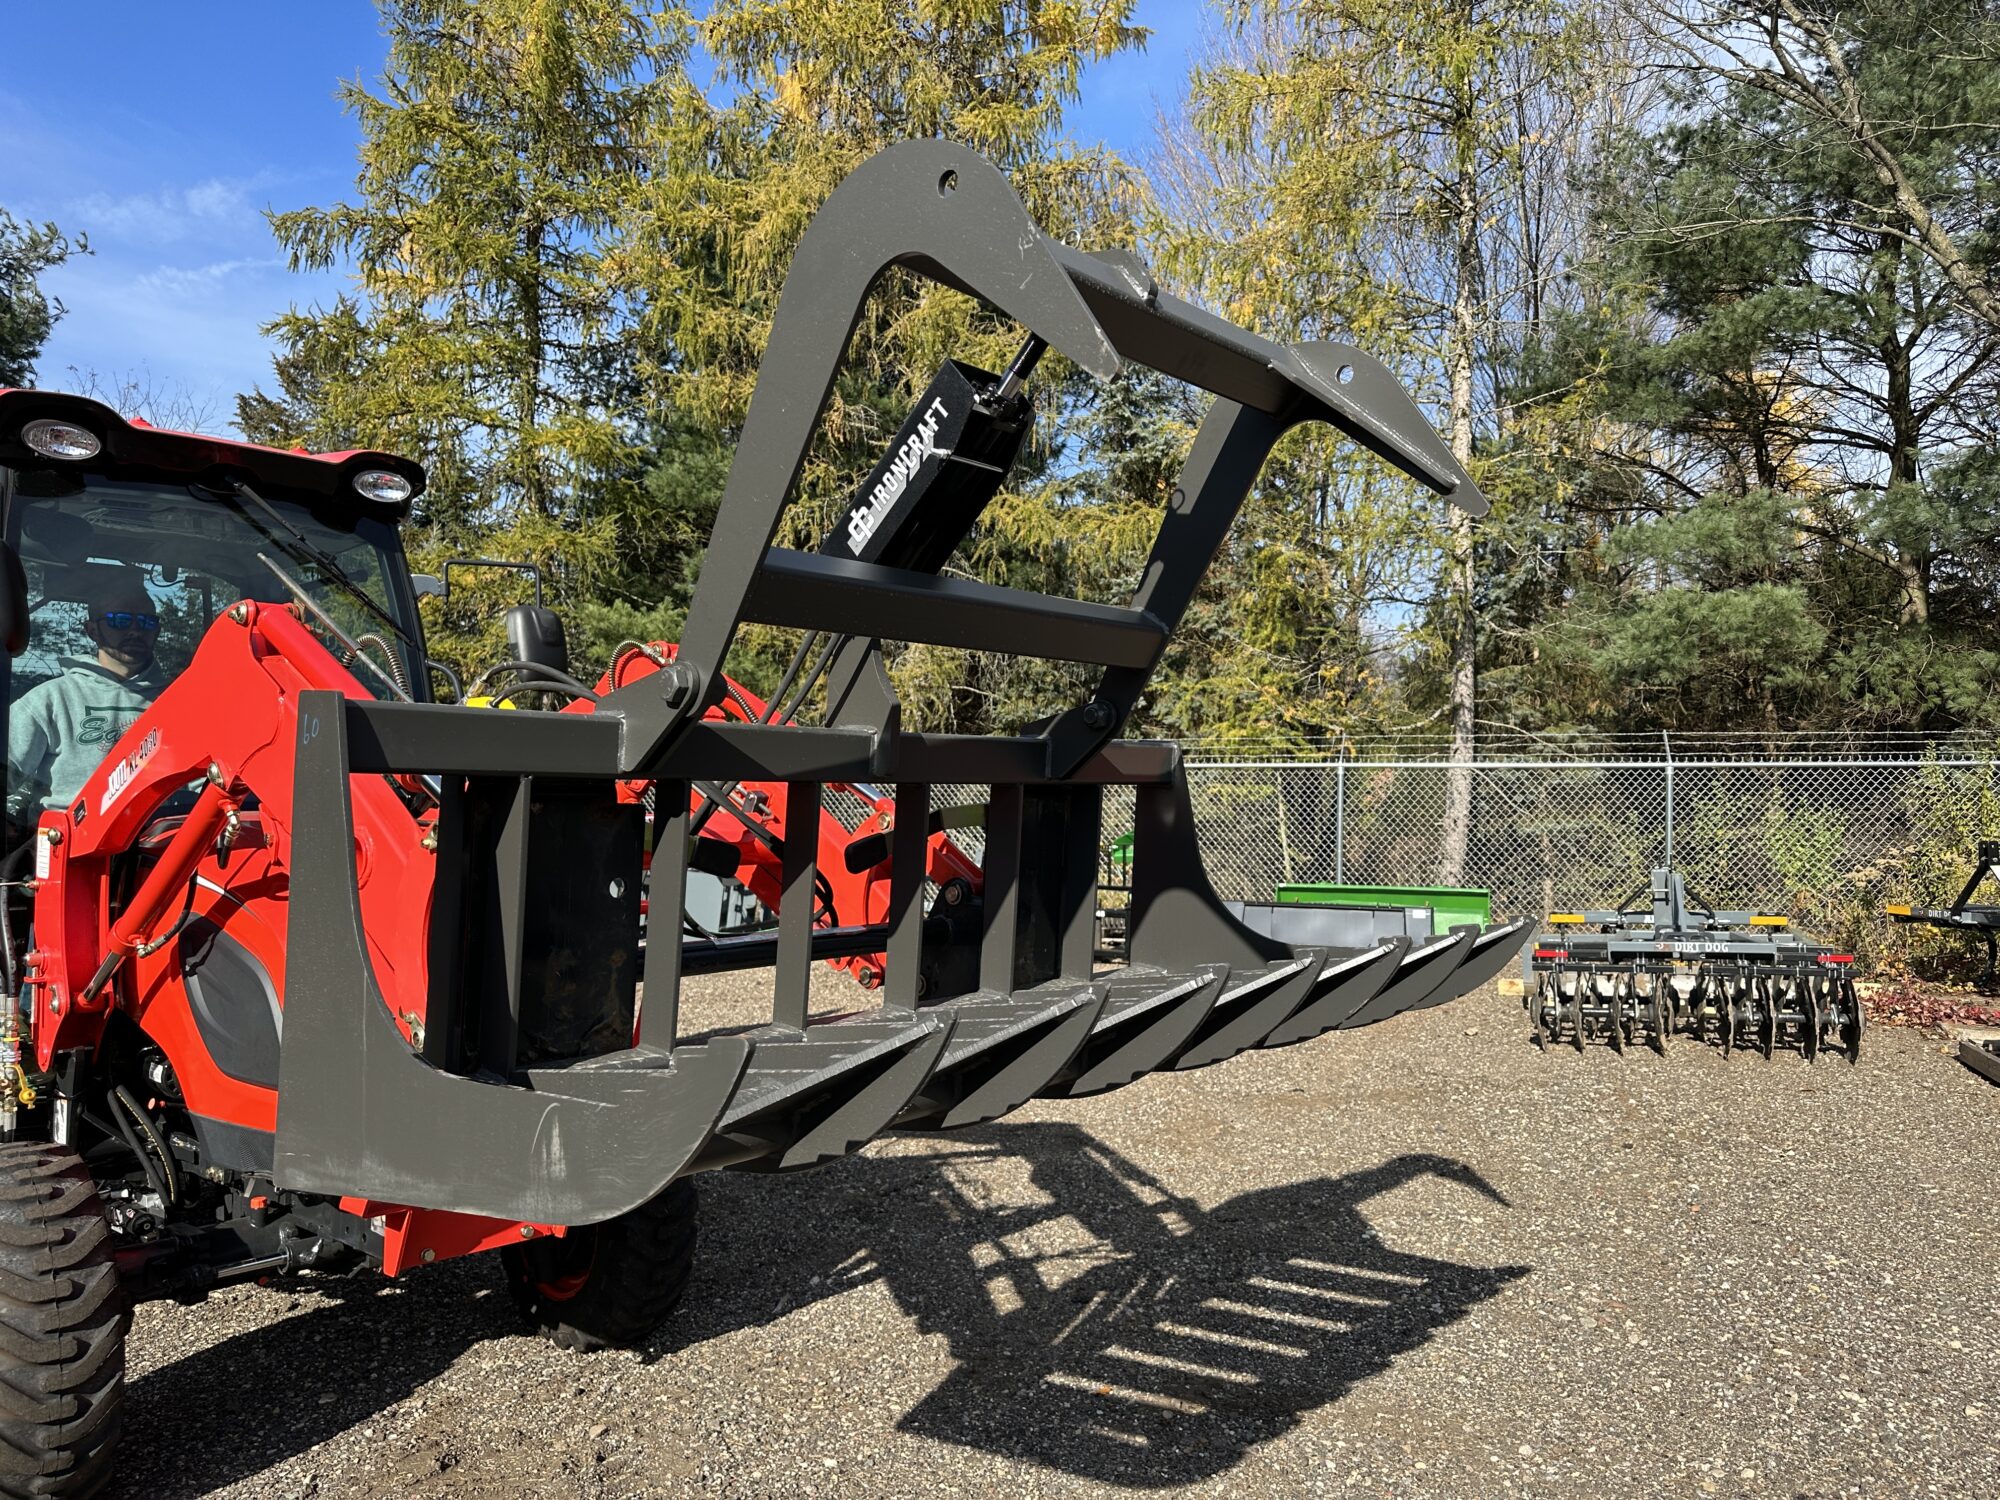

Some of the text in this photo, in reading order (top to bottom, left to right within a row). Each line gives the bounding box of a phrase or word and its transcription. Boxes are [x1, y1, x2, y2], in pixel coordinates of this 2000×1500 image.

[868, 396, 949, 512] IRONCRAFT
[76, 716, 122, 745] Ea
[303, 713, 320, 745] 60
[1928, 909, 1942, 917] DIRT
[1674, 942, 1729, 952] DIRT DOG
